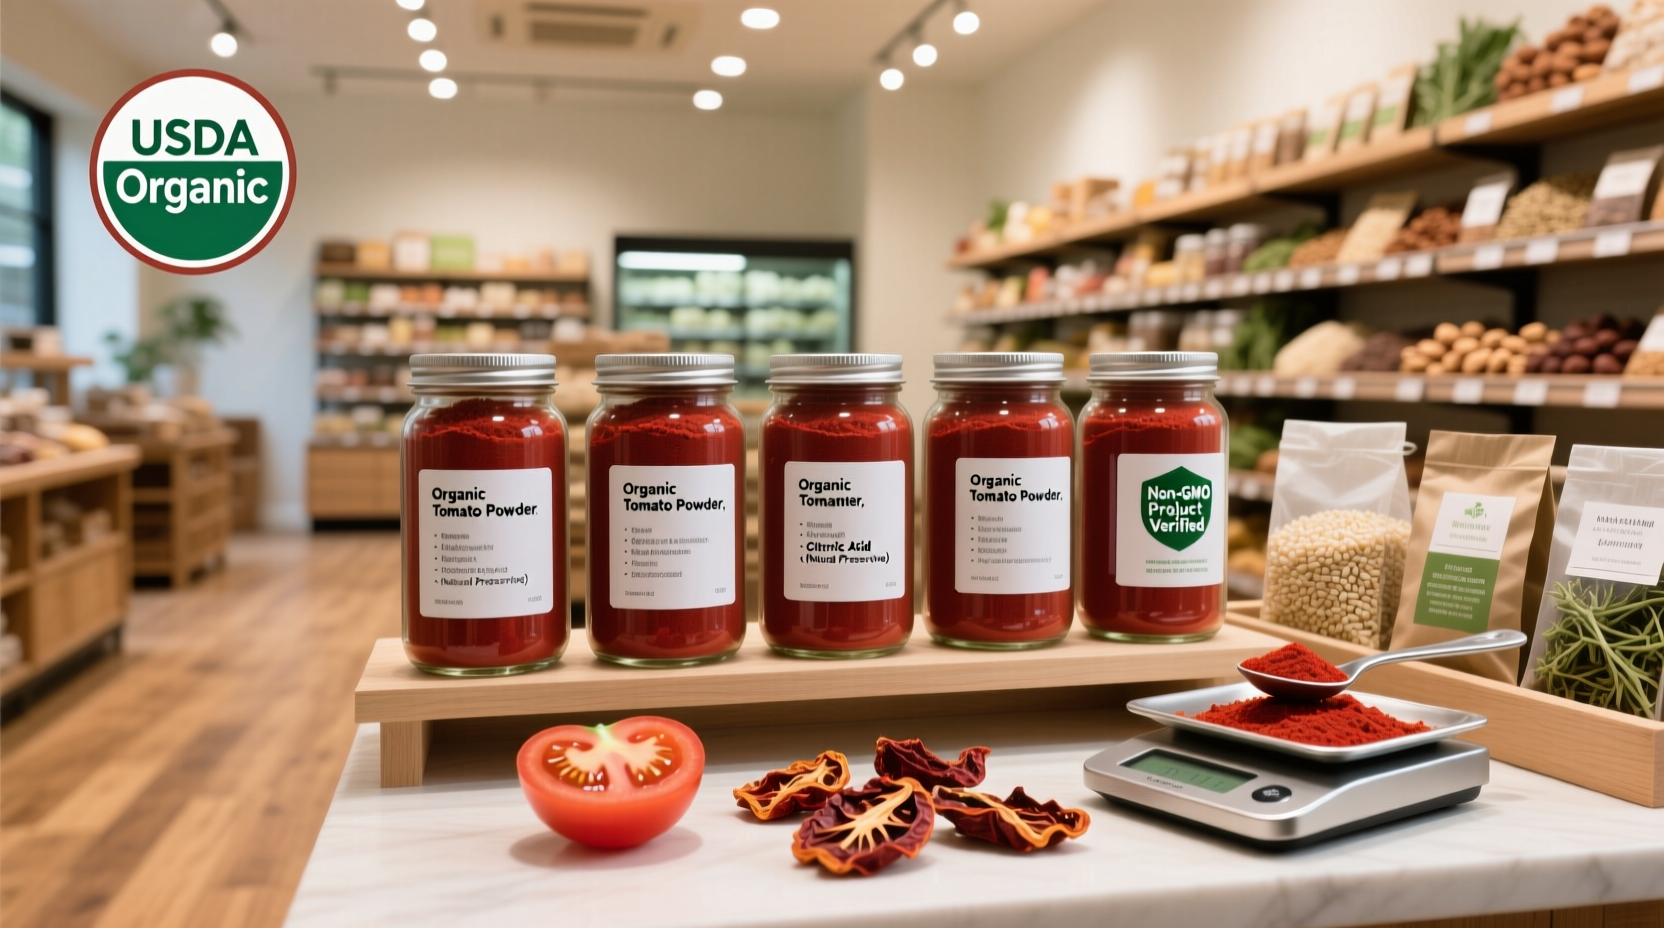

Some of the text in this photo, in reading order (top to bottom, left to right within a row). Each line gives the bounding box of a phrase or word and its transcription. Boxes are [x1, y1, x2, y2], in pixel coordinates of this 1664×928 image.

[798, 477, 851, 493] Organic
[970, 473, 1022, 489] Organic
[432, 487, 486, 503] Organic
[623, 481, 676, 498] Organic
[969, 489, 1017, 502] Tomato
[1147, 484, 1211, 500] Non-GMO
[432, 504, 482, 517] Tomato
[623, 498, 673, 511] Tomato
